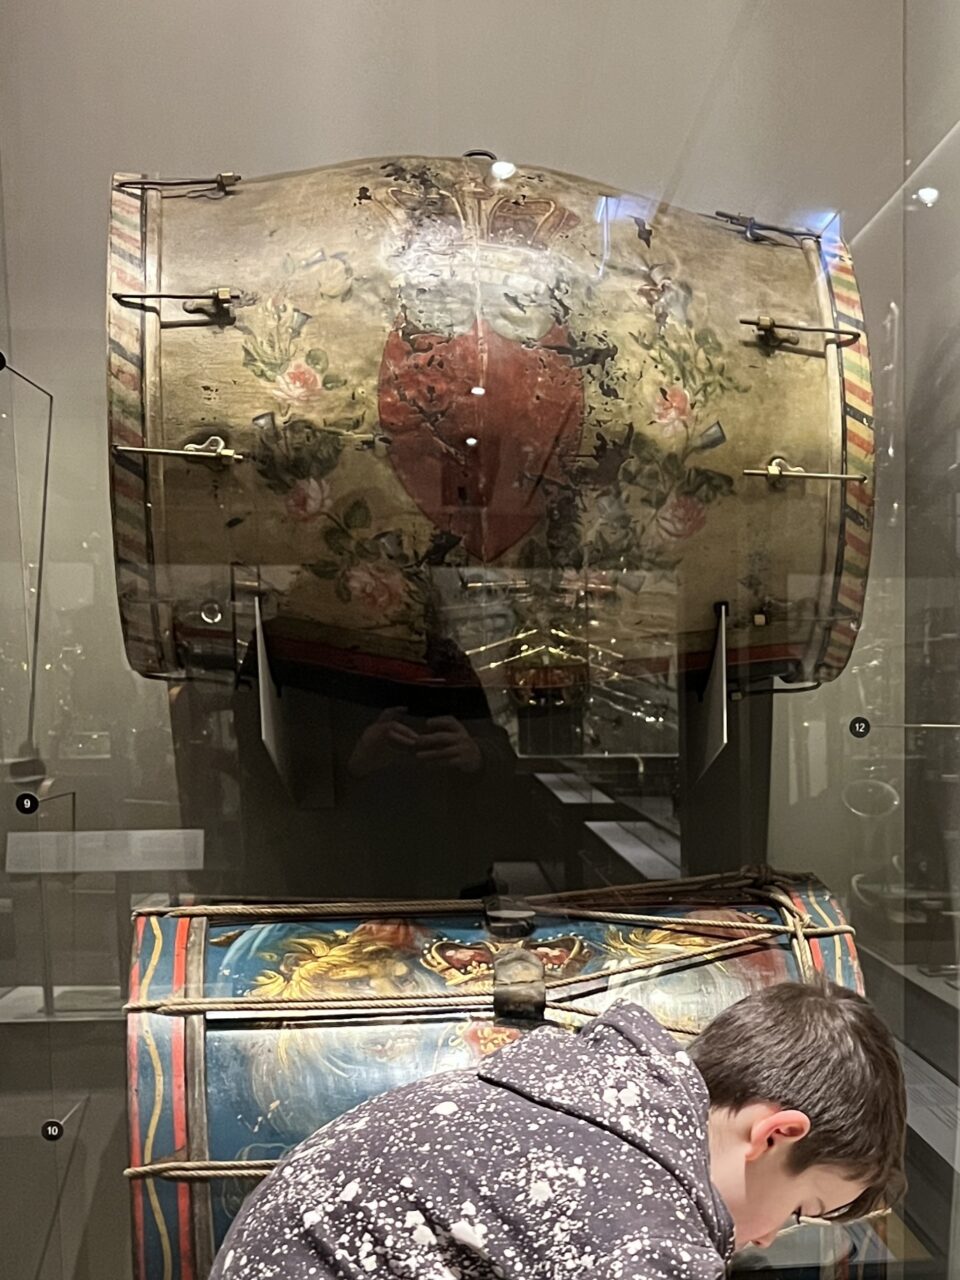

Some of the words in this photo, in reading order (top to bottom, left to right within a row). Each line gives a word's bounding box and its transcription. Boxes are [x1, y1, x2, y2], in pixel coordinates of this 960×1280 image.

[855, 723, 866, 733] 12
[23, 798, 31, 809] 9
[47, 1125, 58, 1136] 10
